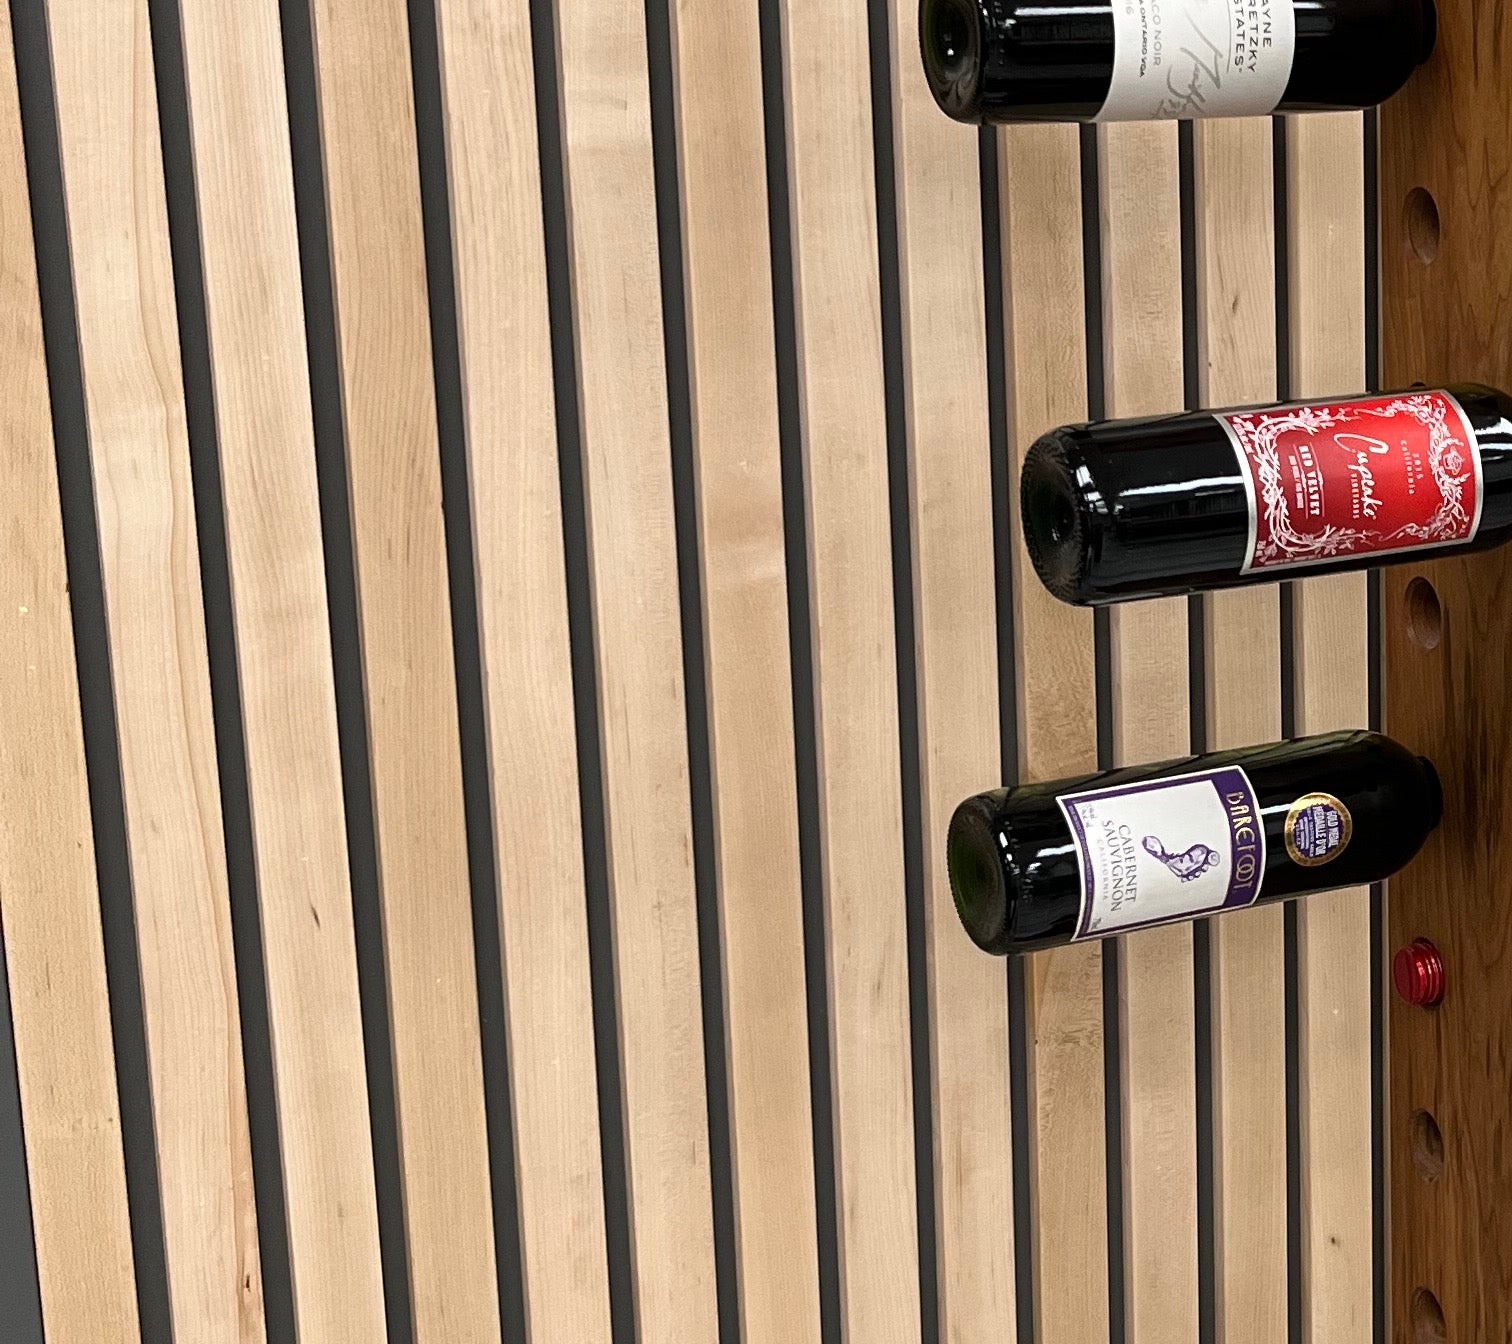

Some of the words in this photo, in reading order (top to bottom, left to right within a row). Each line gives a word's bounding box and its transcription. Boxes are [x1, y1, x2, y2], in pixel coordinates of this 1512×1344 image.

[1153, 30, 1162, 66] NOIR
[1299, 445, 1313, 467] RED
[1307, 471, 1320, 516] VELVET
[1333, 433, 1389, 517] Cupcake
[1102, 819, 1126, 912] SAUVIGNON
[1118, 824, 1138, 903] CABERNET
[1226, 791, 1256, 890] BAREFOOT
